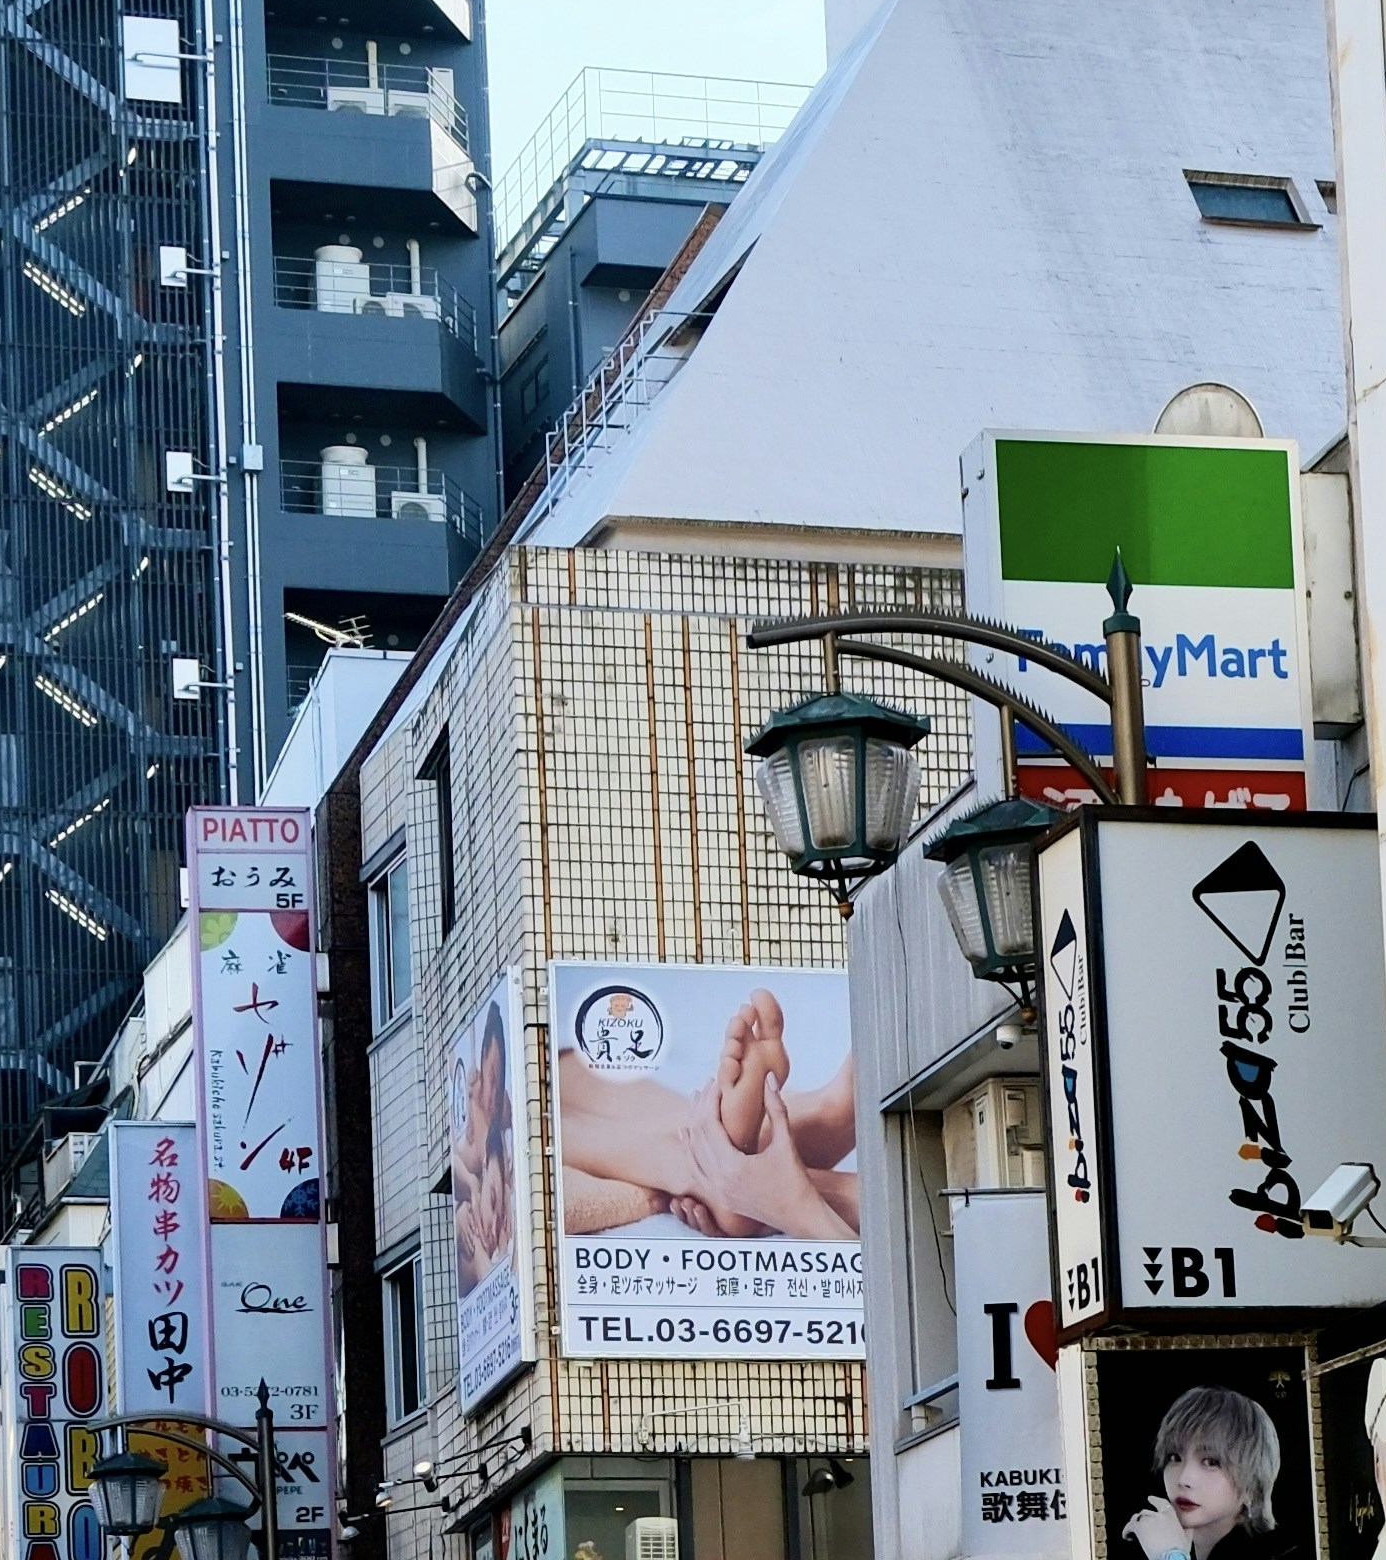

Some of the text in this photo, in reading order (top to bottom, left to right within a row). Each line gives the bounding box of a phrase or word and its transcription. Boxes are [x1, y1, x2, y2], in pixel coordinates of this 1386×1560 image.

[202, 817, 300, 844] PIATTO
[212, 866, 297, 889] おうみ
[277, 894, 304, 909] 5F
[220, 950, 293, 975] 麻雀
[1284, 913, 1310, 1033] Club Bar
[597, 1016, 645, 1030] KIZOKU
[233, 982, 297, 1172] セゾン
[279, 1148, 313, 1174] 4F
[146, 1134, 184, 1307] 名物串カツ
[575, 1247, 651, 1271] BODY
[1171, 1246, 1238, 1298] B1
[578, 1315, 867, 1346] TEL.03-6697-521
[146, 1310, 194, 1404] 田中
[290, 1403, 319, 1420] 3F
[295, 1507, 324, 1523] 2F
